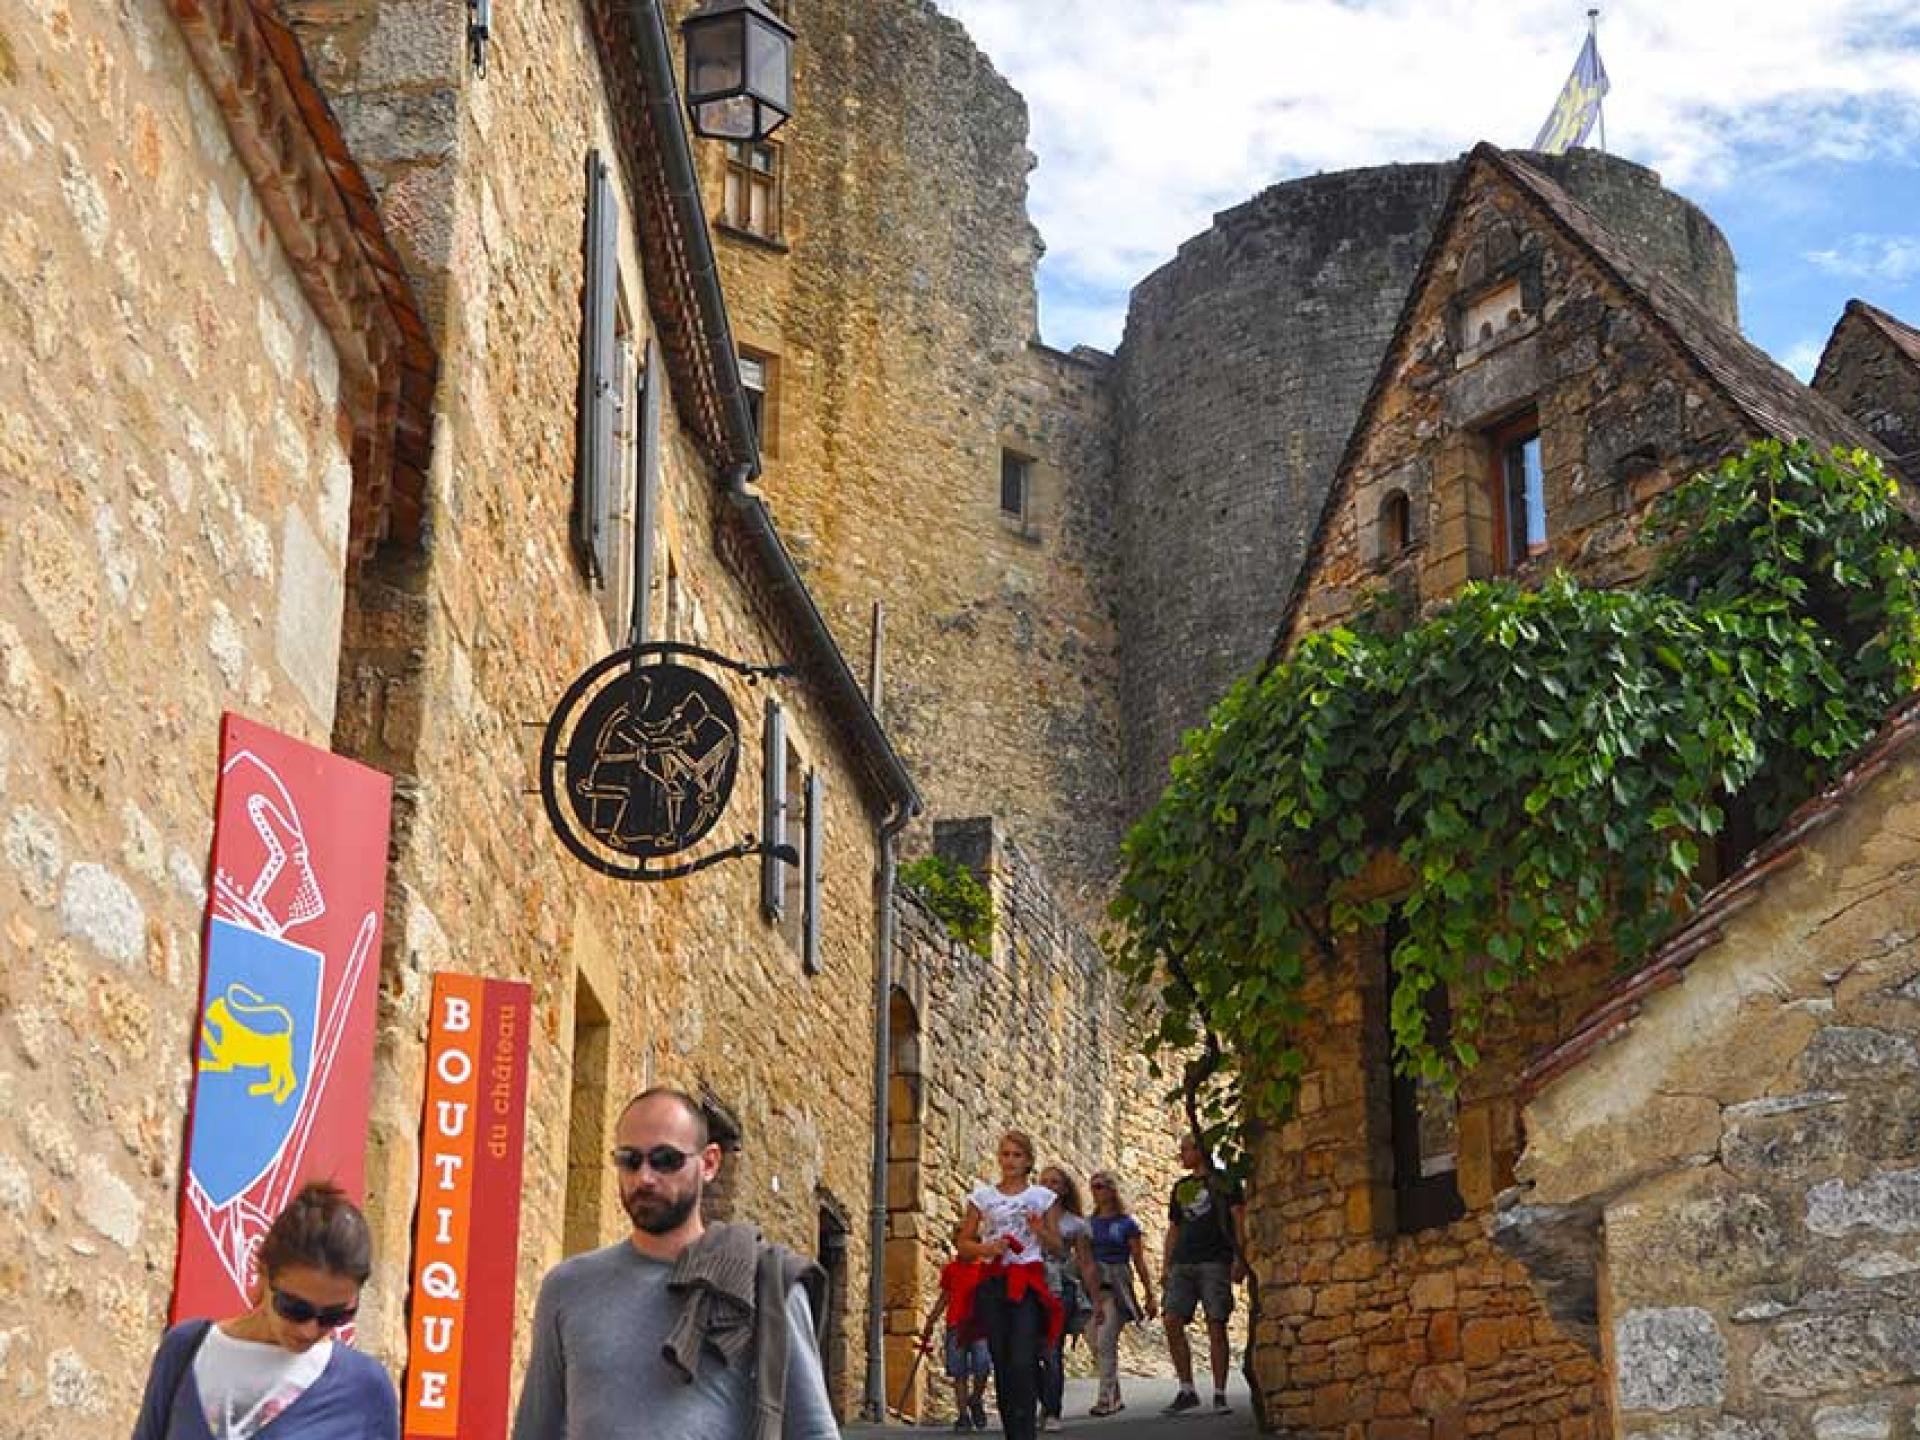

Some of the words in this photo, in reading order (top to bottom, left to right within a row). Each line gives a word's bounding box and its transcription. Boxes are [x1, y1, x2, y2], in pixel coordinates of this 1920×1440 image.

[490, 1004, 516, 1114] château
[487, 1124, 507, 1159] du
[419, 997, 472, 1409] BOUTIQUE
